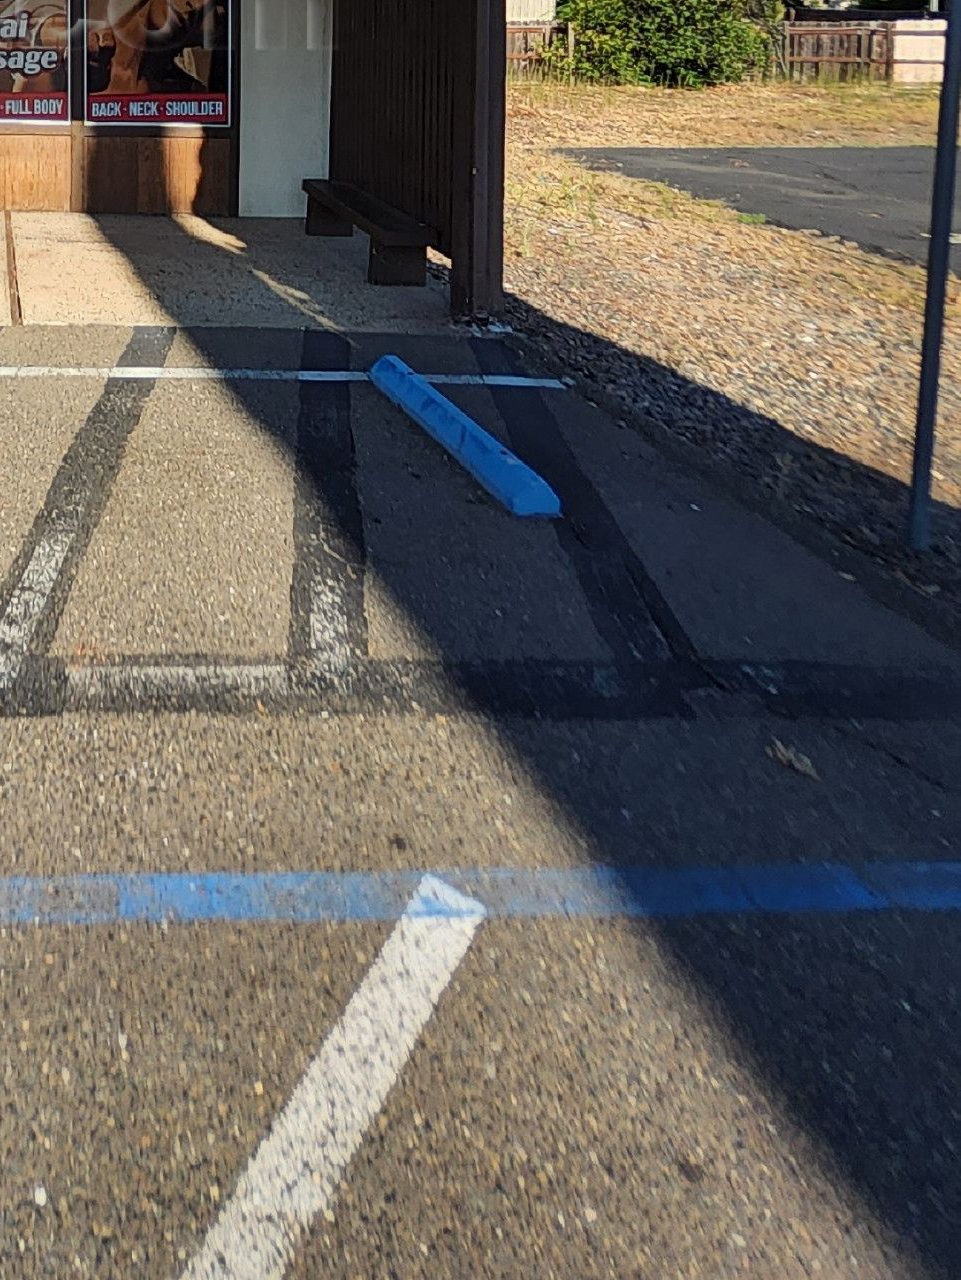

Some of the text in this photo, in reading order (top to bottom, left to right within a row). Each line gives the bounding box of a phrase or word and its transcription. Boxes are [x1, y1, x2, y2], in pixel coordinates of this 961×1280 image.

[5, 99, 32, 115] FULL
[34, 99, 63, 115] BODY
[91, 101, 223, 117] BACK NECK SHOULDER
